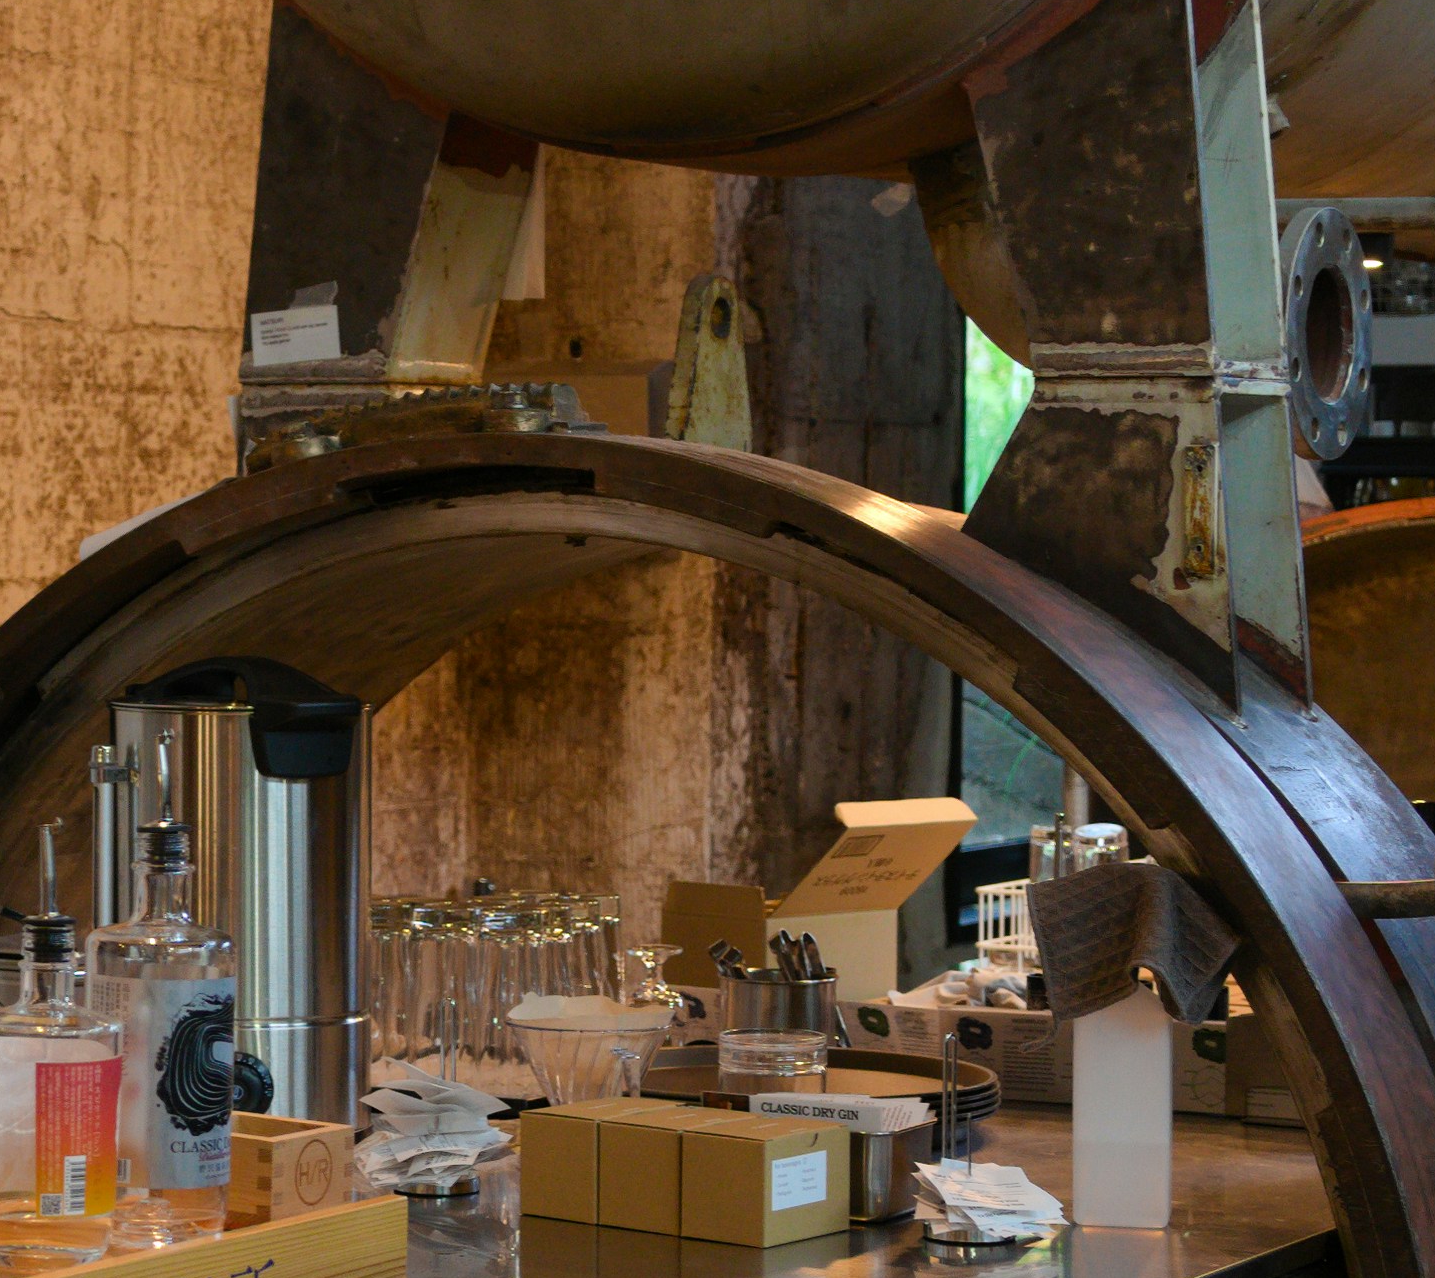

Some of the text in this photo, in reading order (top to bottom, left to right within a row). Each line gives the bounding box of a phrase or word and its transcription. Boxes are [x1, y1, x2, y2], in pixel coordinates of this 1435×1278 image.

[760, 1102, 859, 1121] CLASSIC DRY GIN
[170, 1138, 223, 1154] CLASSIC
